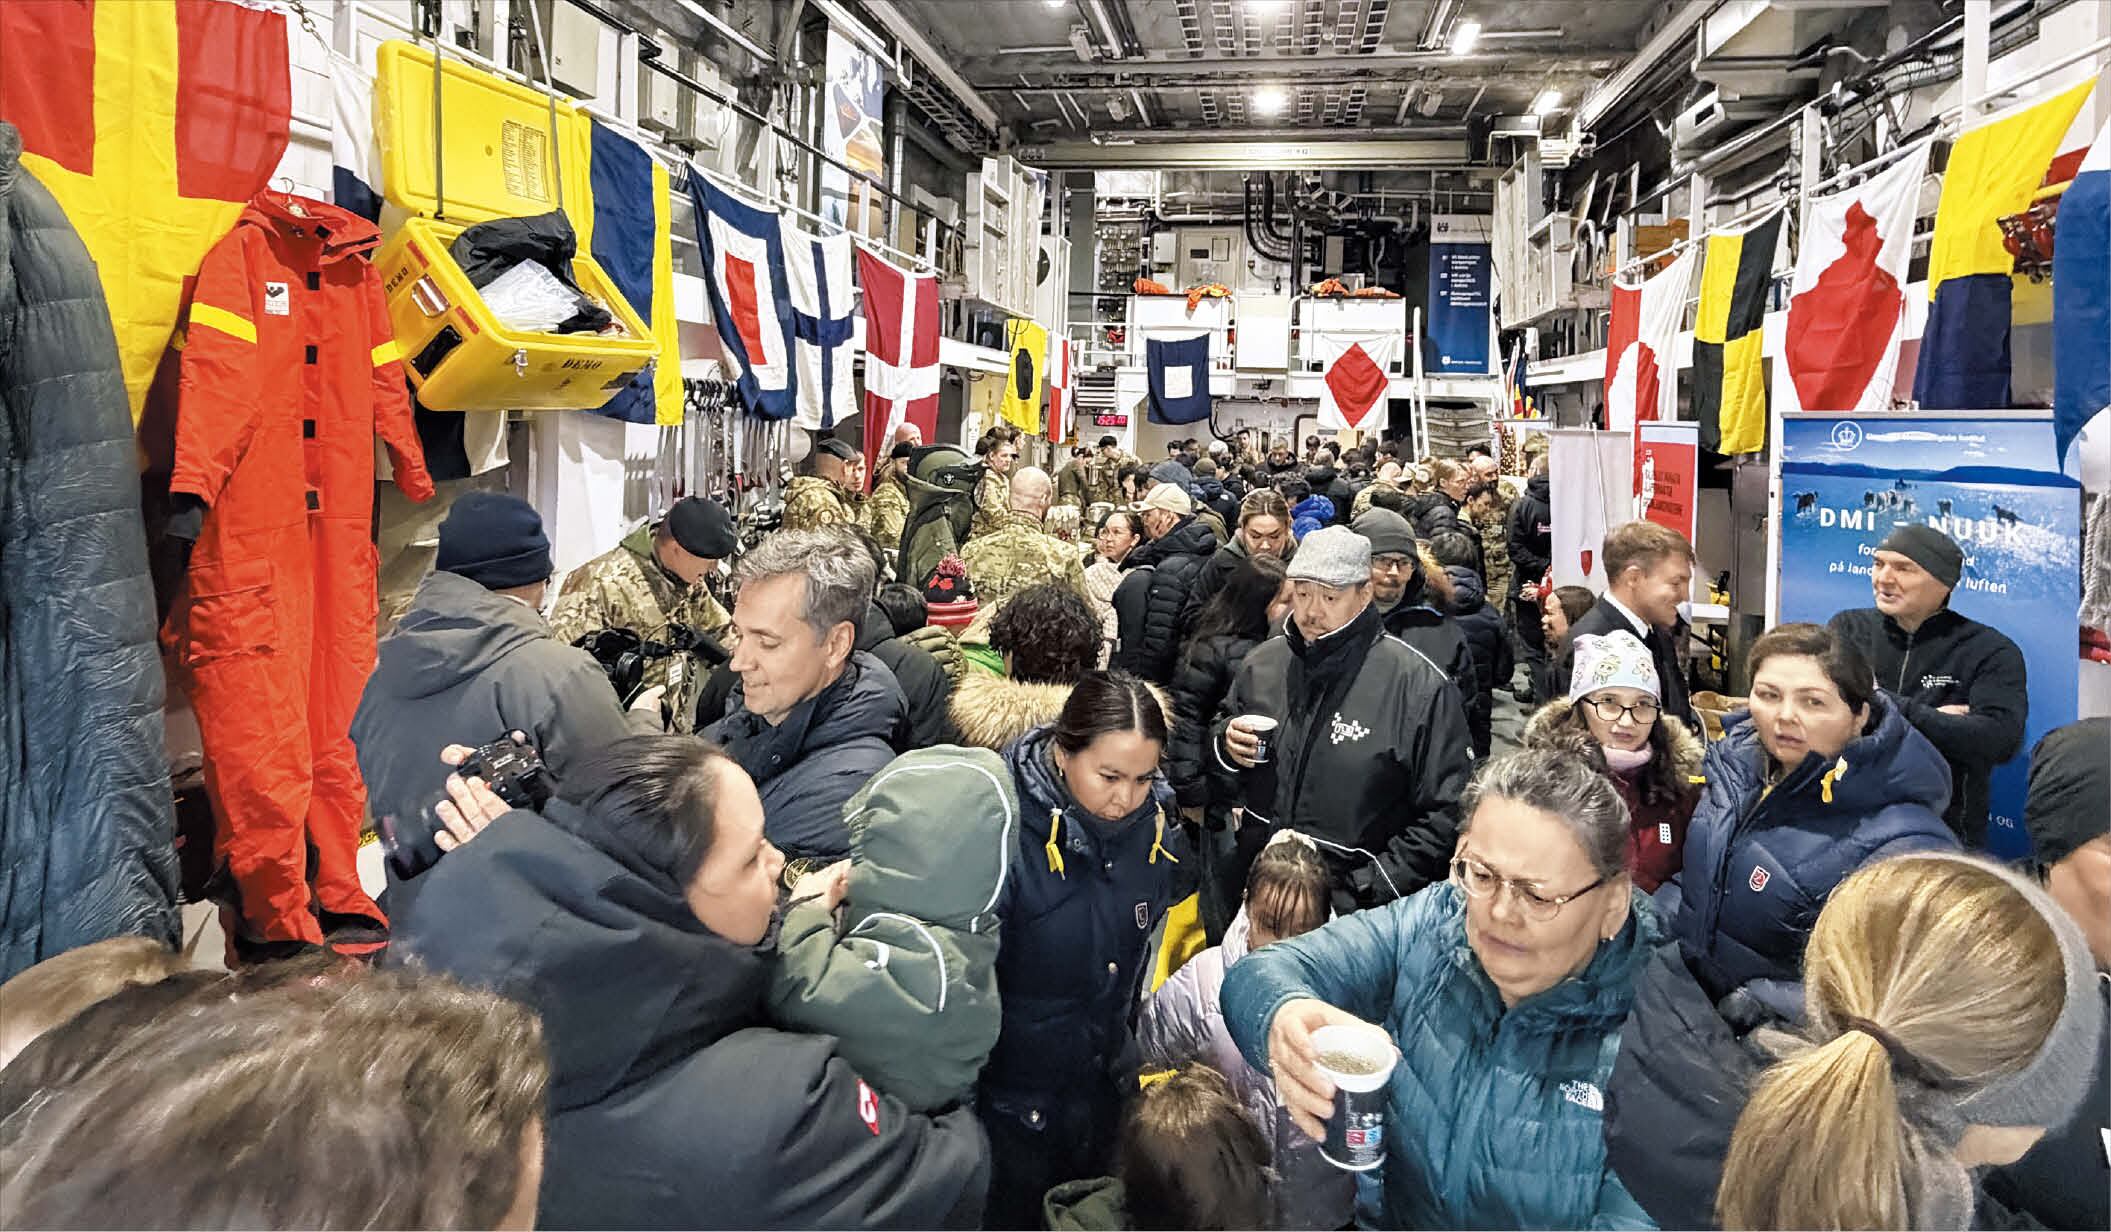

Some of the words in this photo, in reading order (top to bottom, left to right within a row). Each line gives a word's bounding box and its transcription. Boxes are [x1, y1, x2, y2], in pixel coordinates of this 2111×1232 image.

[385, 266, 409, 293] DEMO
[561, 357, 603, 370] DEMO
[1819, 507, 1875, 531] DMI
[1928, 514, 2022, 548] NUUK
[1965, 577, 2008, 594] luften
[1572, 1079, 1589, 1091] THE
